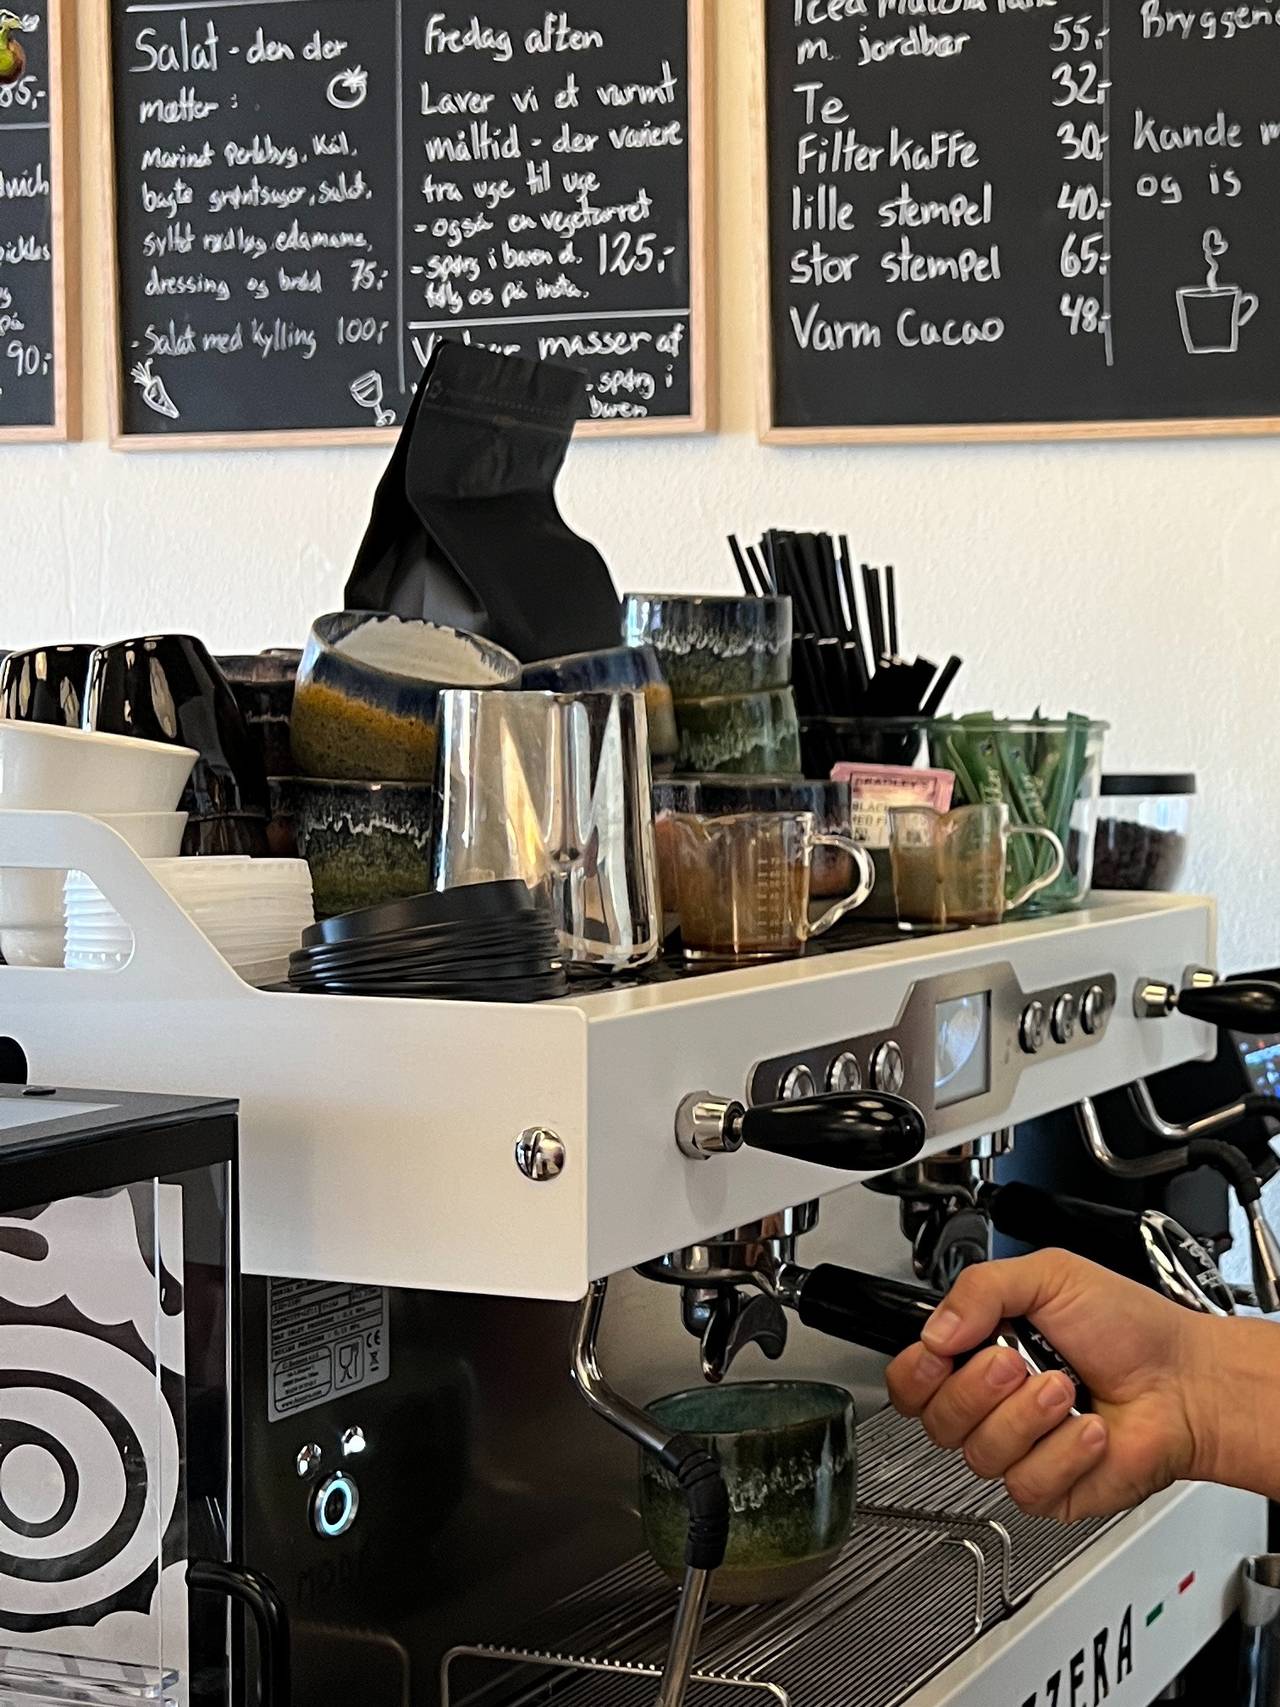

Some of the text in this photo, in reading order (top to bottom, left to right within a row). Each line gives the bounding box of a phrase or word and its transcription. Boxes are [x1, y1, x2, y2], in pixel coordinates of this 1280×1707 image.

[129, 17, 219, 72] Salat
[245, 27, 294, 62] den
[424, 11, 604, 62] Fredag aften
[420, 60, 678, 116] Laver vi et varmt
[792, 80, 850, 125] Te
[425, 121, 522, 163] måltid
[551, 122, 600, 155] der
[473, 180, 516, 209] uge
[525, 158, 552, 197] til
[1136, 173, 1183, 205] og
[1207, 160, 1242, 197] is
[507, 208, 538, 233] en
[791, 182, 856, 231] lille
[876, 180, 993, 228] stempel
[488, 247, 498, 270] i
[789, 239, 859, 286] stor
[879, 233, 1001, 283] stempel
[144, 266, 231, 301] dressing
[246, 277, 270, 299] og
[468, 286, 495, 306] os
[501, 280, 529, 308] på
[203, 328, 243, 353] med
[538, 331, 653, 361] masser
[656, 322, 685, 358] af
[788, 301, 882, 352] Varm
[896, 307, 1005, 348] Cacao
